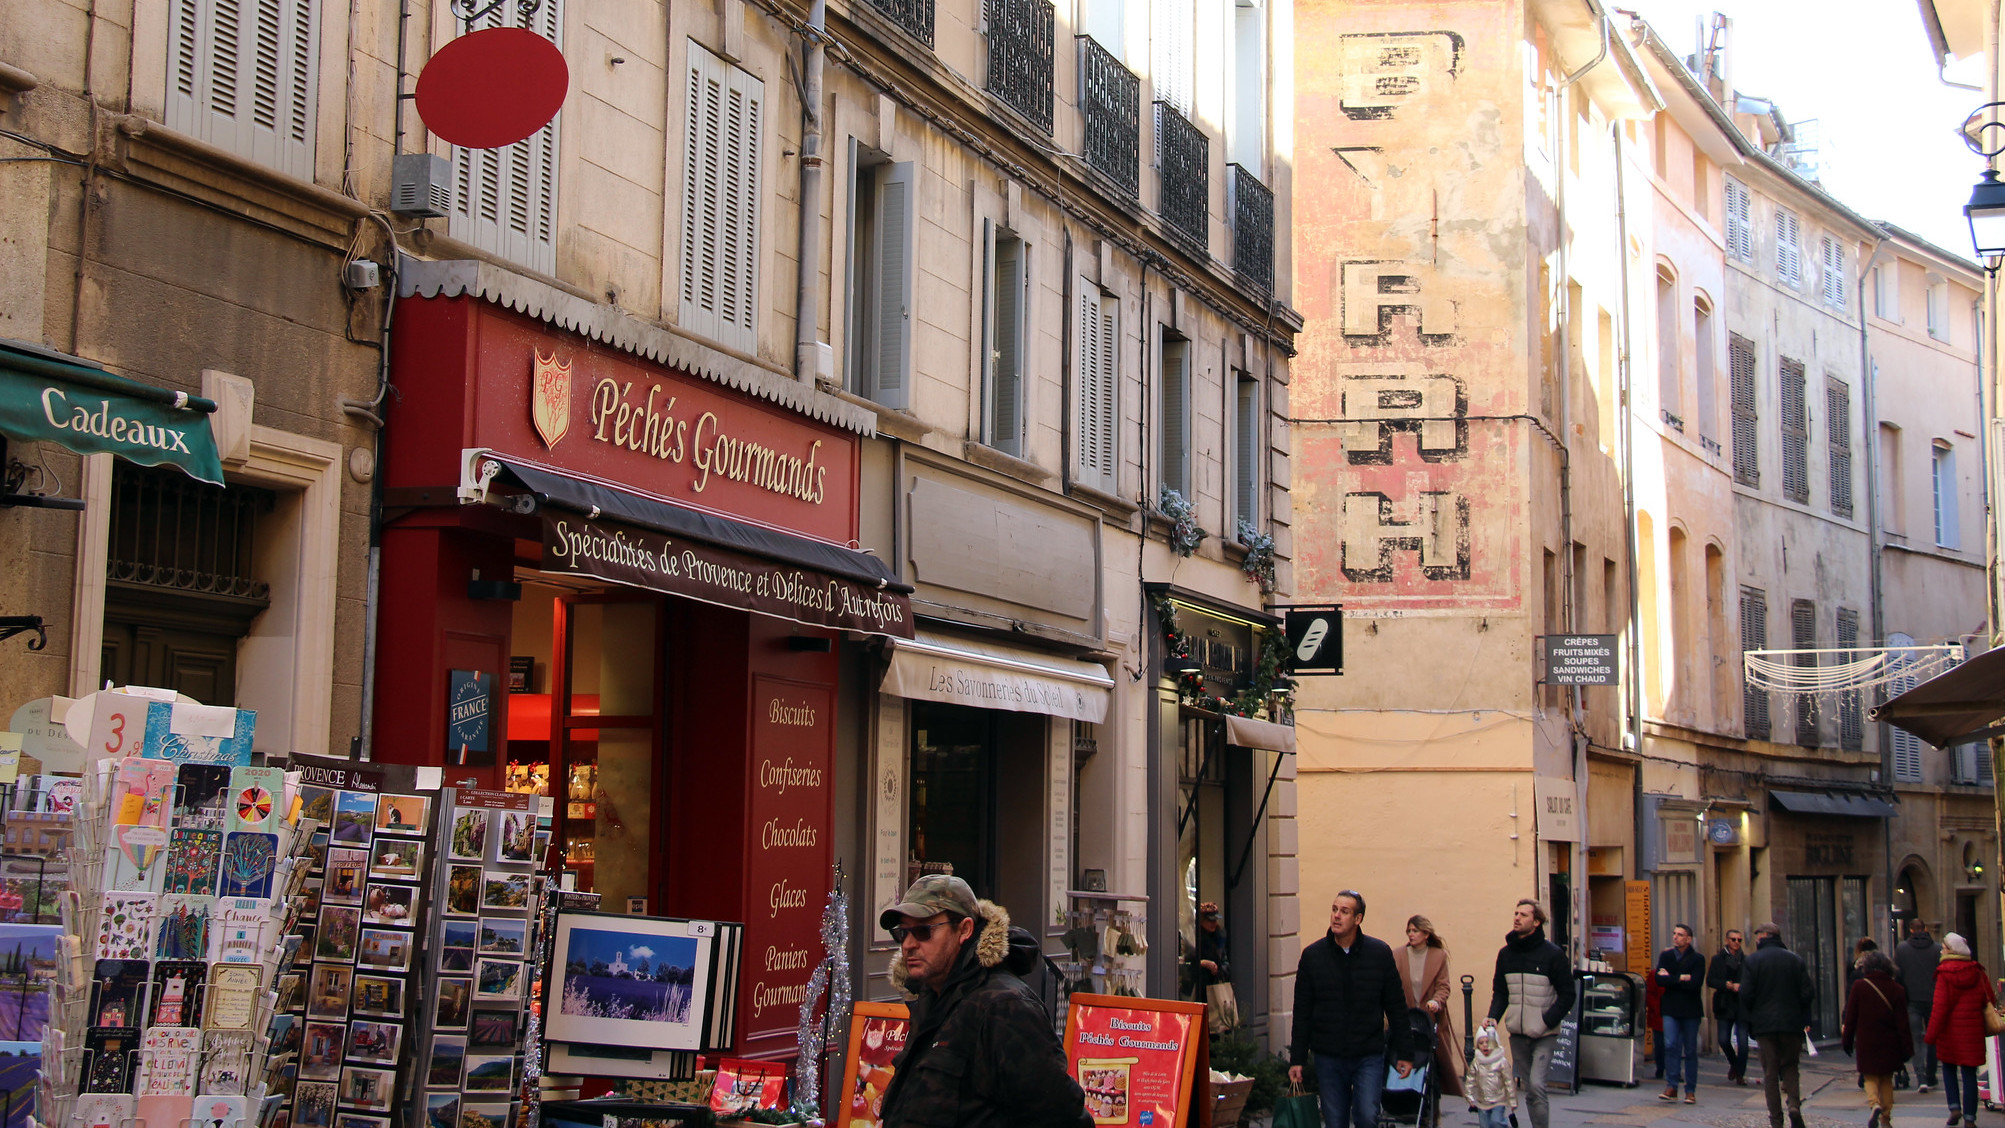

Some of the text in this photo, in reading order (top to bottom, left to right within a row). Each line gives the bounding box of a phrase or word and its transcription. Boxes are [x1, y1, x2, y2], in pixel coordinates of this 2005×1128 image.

[41, 387, 191, 455] Cadeaux
[592, 377, 826, 505] Péchés Gourmands
[552, 520, 656, 572] Spécialités
[660, 540, 680, 577] de
[682, 550, 752, 594] Provence
[756, 572, 769, 598] et
[772, 571, 824, 610] Délices
[1564, 637, 1598, 646] CRÊPES
[1553, 666, 1611, 674] SANDWICHES
[1564, 657, 1599, 665] SOUPES
[929, 666, 952, 693] Les
[957, 669, 1022, 703] Savonneries
[1024, 682, 1038, 704] du
[452, 698, 487, 721] FRANCE
[769, 698, 816, 727] Biscuits
[160, 735, 237, 762] Christmas
[245, 768, 271, 777] 2020
[294, 764, 346, 785] PROVENCE
[760, 756, 821, 795] Confiseries
[762, 817, 817, 850] Chocolats
[770, 878, 807, 918] Glaces
[224, 909, 263, 923] Chance
[765, 942, 808, 971] Paniers
[754, 981, 807, 1018] Gourman
[1110, 1017, 1152, 1032] Biscuits
[1079, 1032, 1179, 1051] Péchés Gourmands
